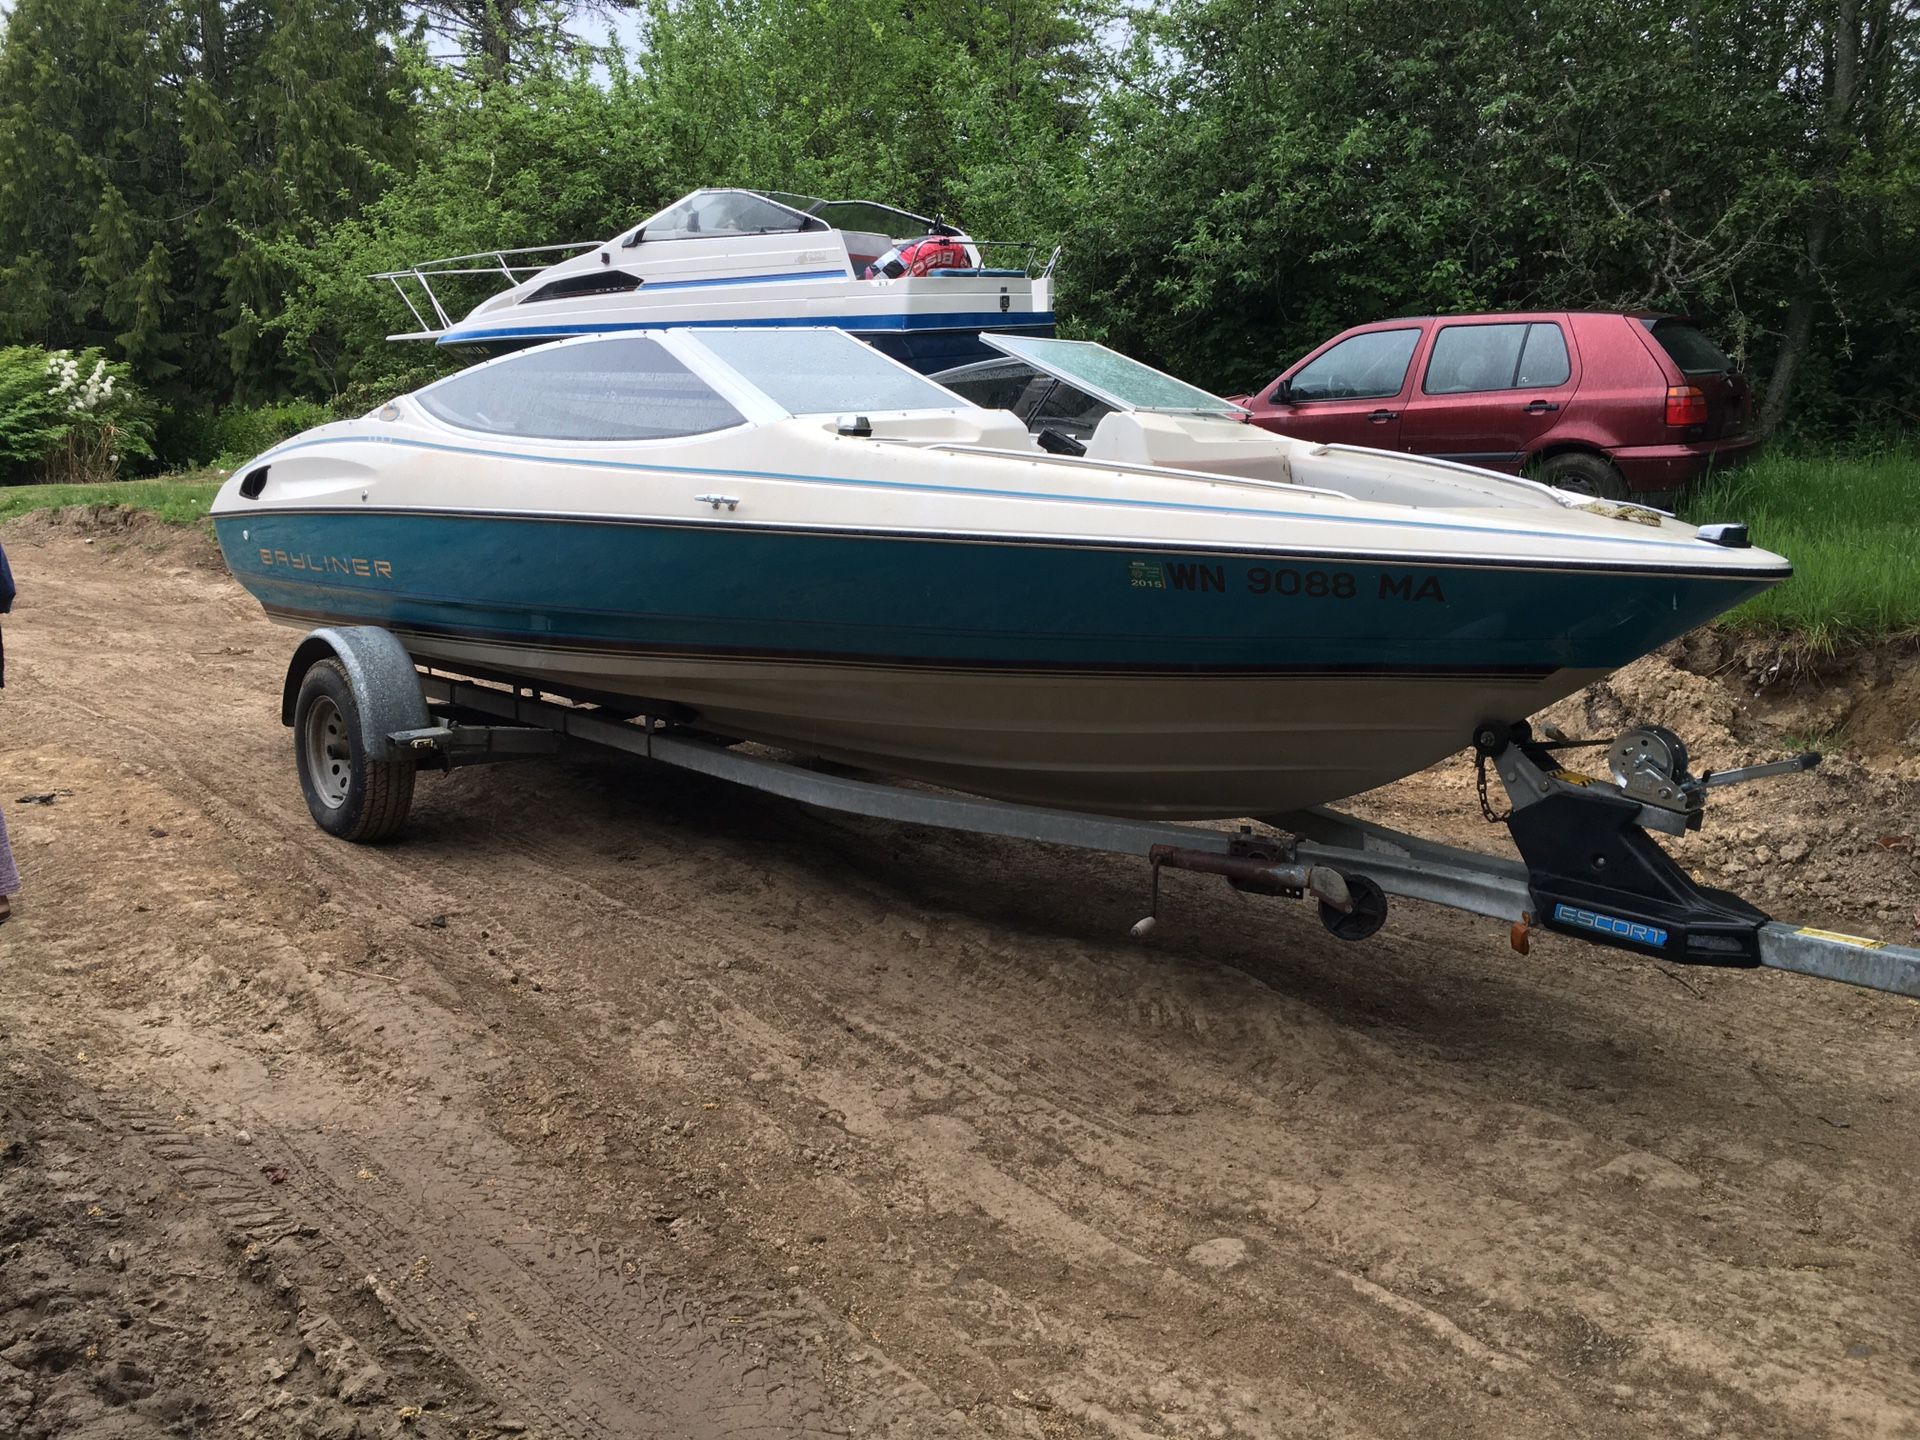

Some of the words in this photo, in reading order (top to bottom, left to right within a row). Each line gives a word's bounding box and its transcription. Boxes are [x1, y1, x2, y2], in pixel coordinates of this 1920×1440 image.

[260, 548, 392, 578] BAYLINER
[1130, 579, 1162, 589] 2015
[1165, 562, 1226, 593] WN
[1247, 567, 1357, 599] 9088
[1378, 573, 1446, 602] MA
[1558, 905, 1667, 944] ESCORT
